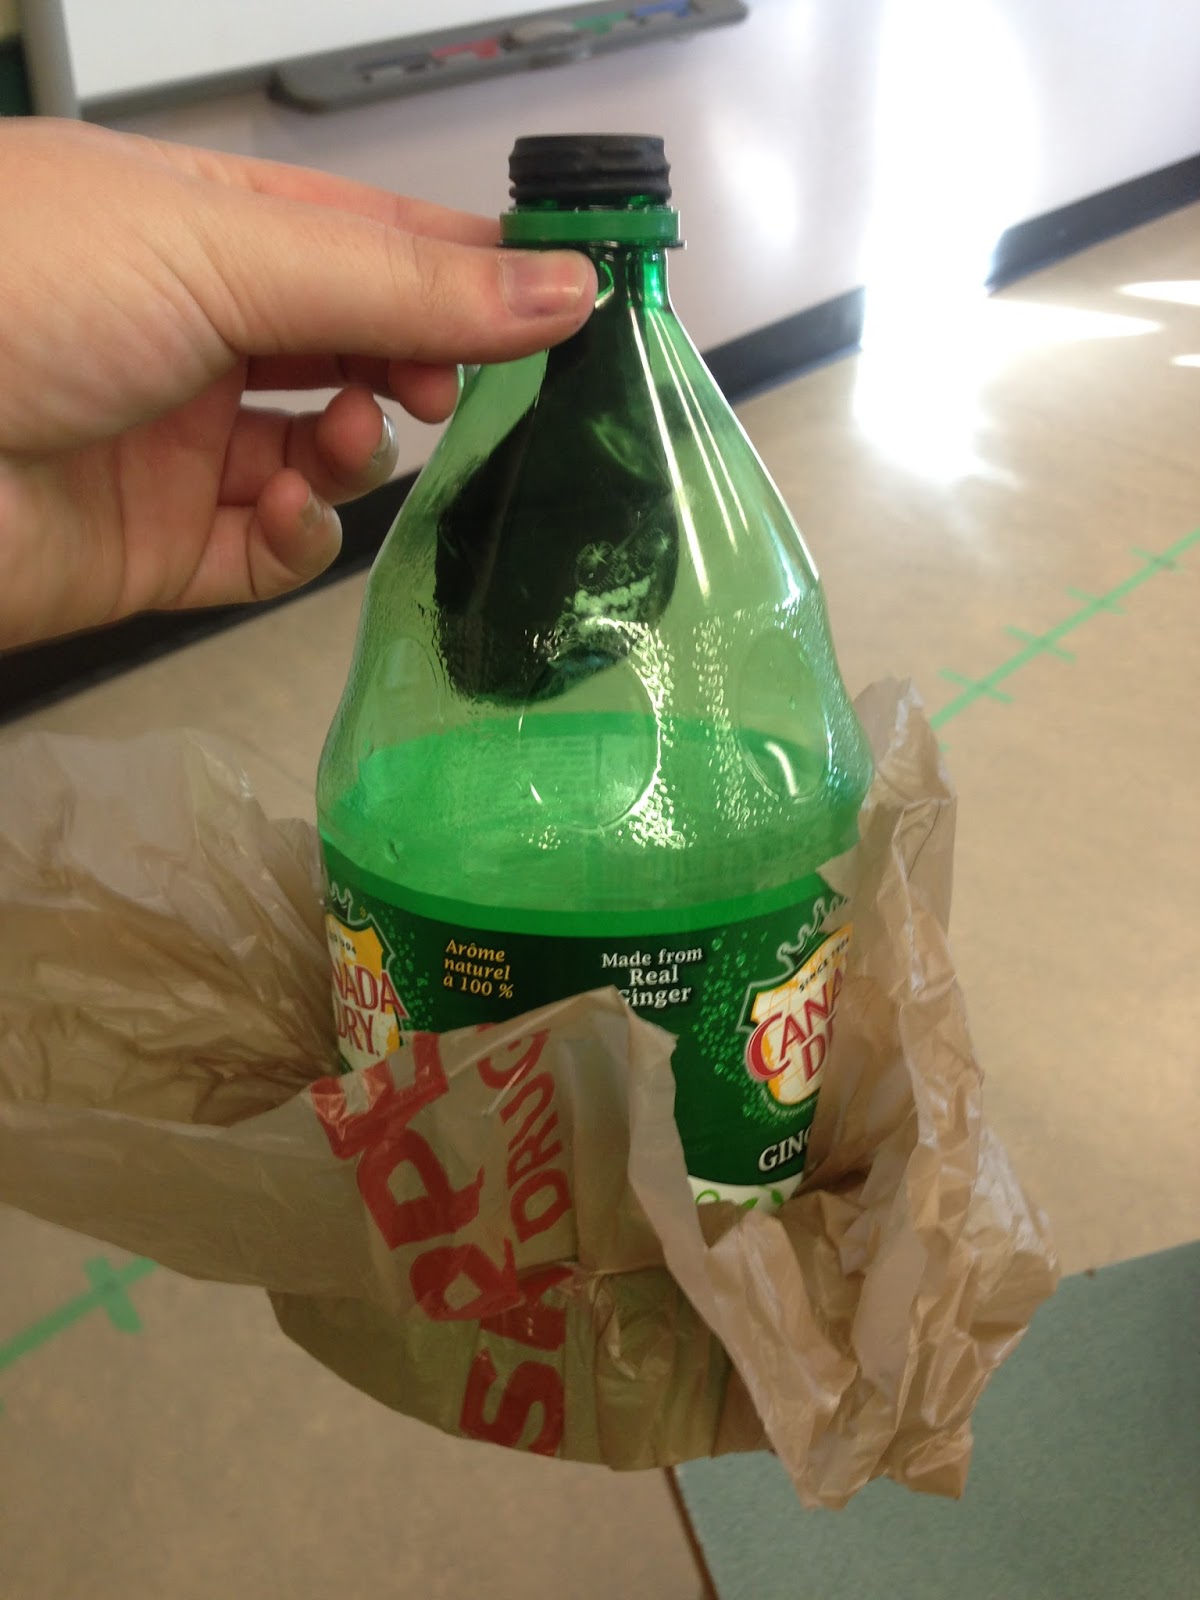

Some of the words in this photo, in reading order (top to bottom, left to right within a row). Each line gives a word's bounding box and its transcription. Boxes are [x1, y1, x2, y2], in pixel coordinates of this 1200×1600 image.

[445, 938, 506, 962] Arôme
[601, 950, 652, 968] Made
[657, 947, 703, 965] from
[444, 956, 511, 981] naturel
[628, 964, 680, 987] Real
[332, 962, 408, 1018] NADA
[442, 971, 454, 988] à
[460, 975, 493, 997] 100
[498, 983, 515, 1000] %
[758, 1123, 813, 1172] GIN
